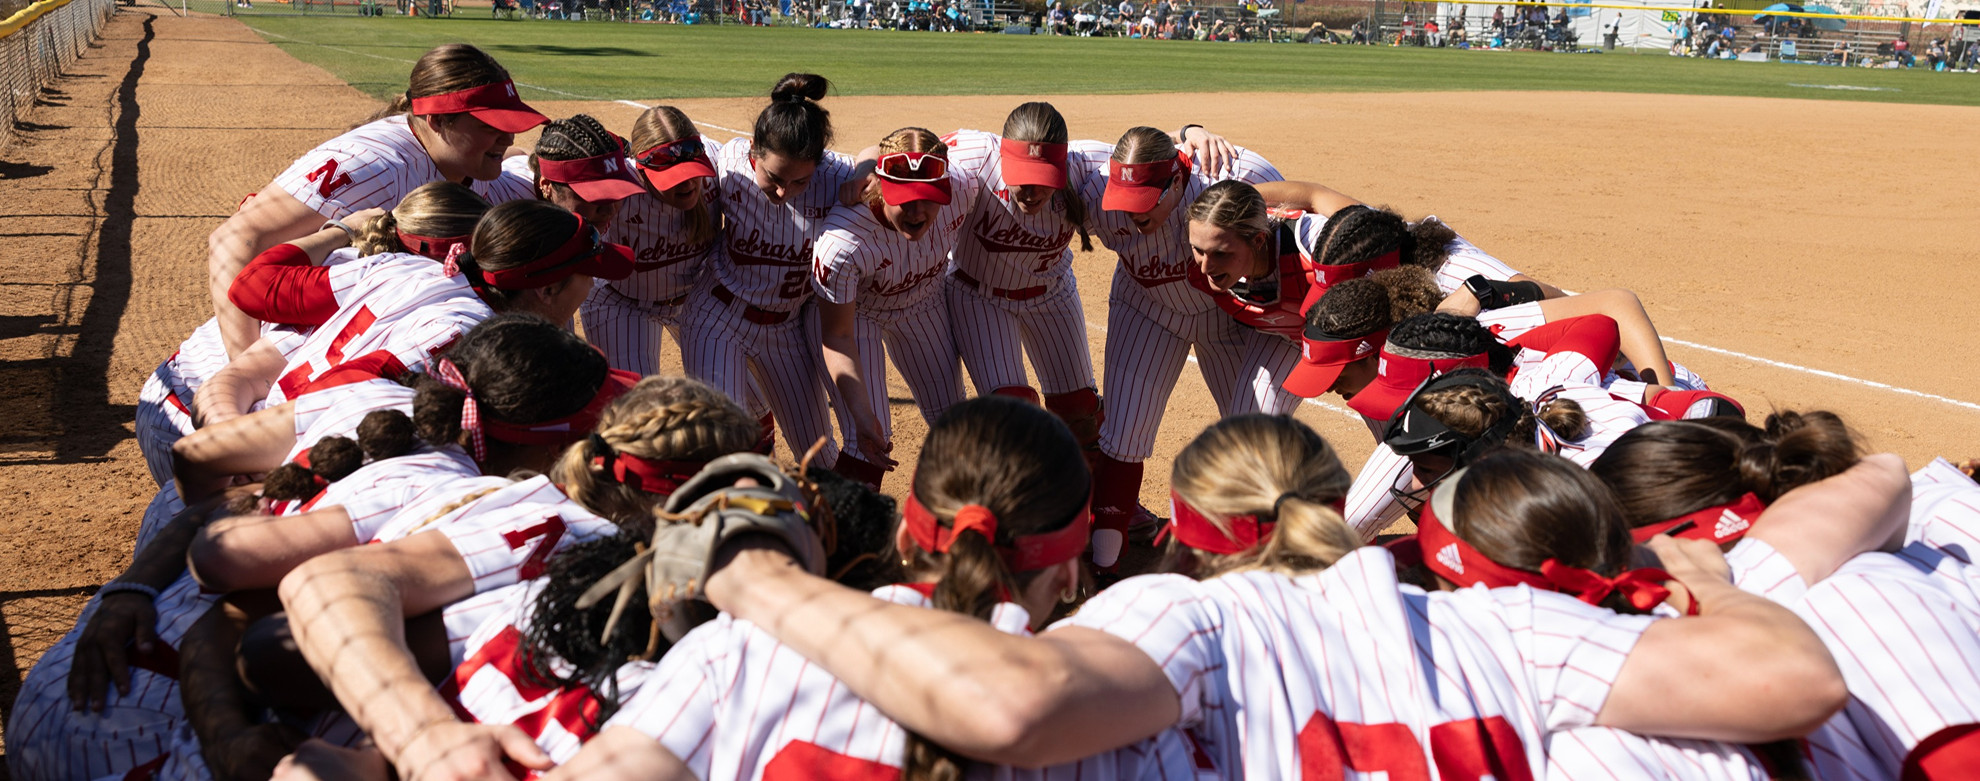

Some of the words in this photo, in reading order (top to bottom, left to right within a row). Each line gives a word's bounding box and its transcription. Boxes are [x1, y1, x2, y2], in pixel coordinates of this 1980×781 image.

[1028, 144, 1042, 157] N
[304, 157, 354, 200] N
[603, 157, 619, 174] N
[1121, 167, 1134, 182] N
[727, 222, 813, 261] Nebrask
[973, 211, 1074, 248] Nebrask
[814, 256, 832, 288] N
[1120, 253, 1188, 278] Nebra
[1314, 268, 1327, 285] N
[779, 270, 814, 299] 2
